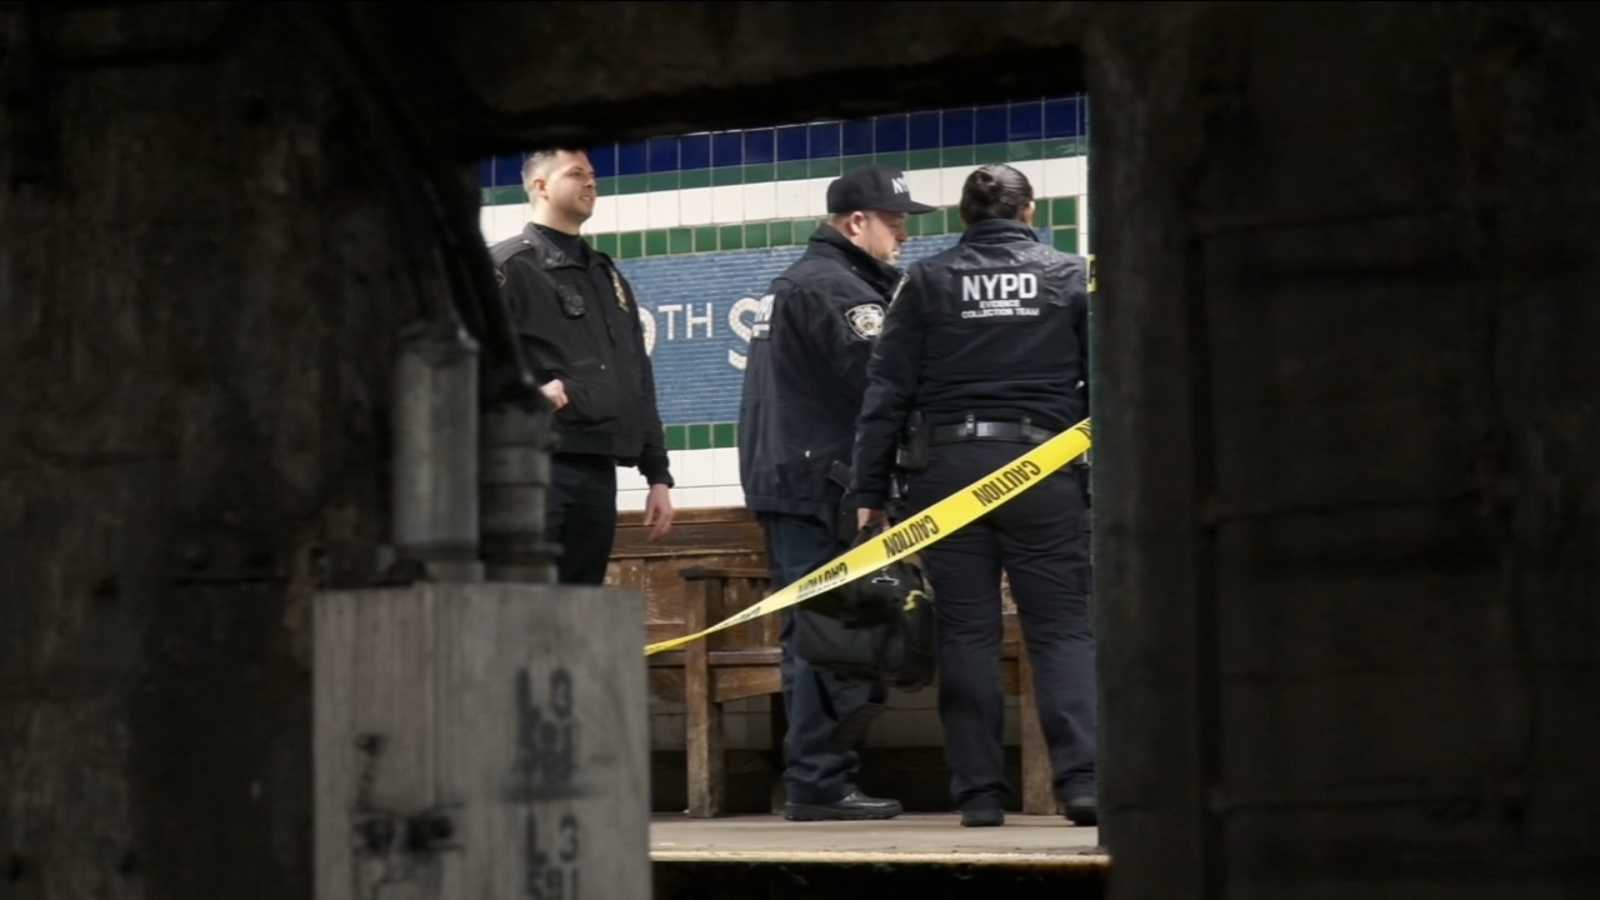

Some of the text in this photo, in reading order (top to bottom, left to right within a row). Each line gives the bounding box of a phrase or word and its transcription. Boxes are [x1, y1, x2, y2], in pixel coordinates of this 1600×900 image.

[962, 273, 1037, 301] NYPD
[728, 297, 760, 370] S
[961, 307, 1040, 319] COLLECTION TEAM
[971, 460, 1042, 507] CAUTION
[882, 515, 940, 559] CAUTION
